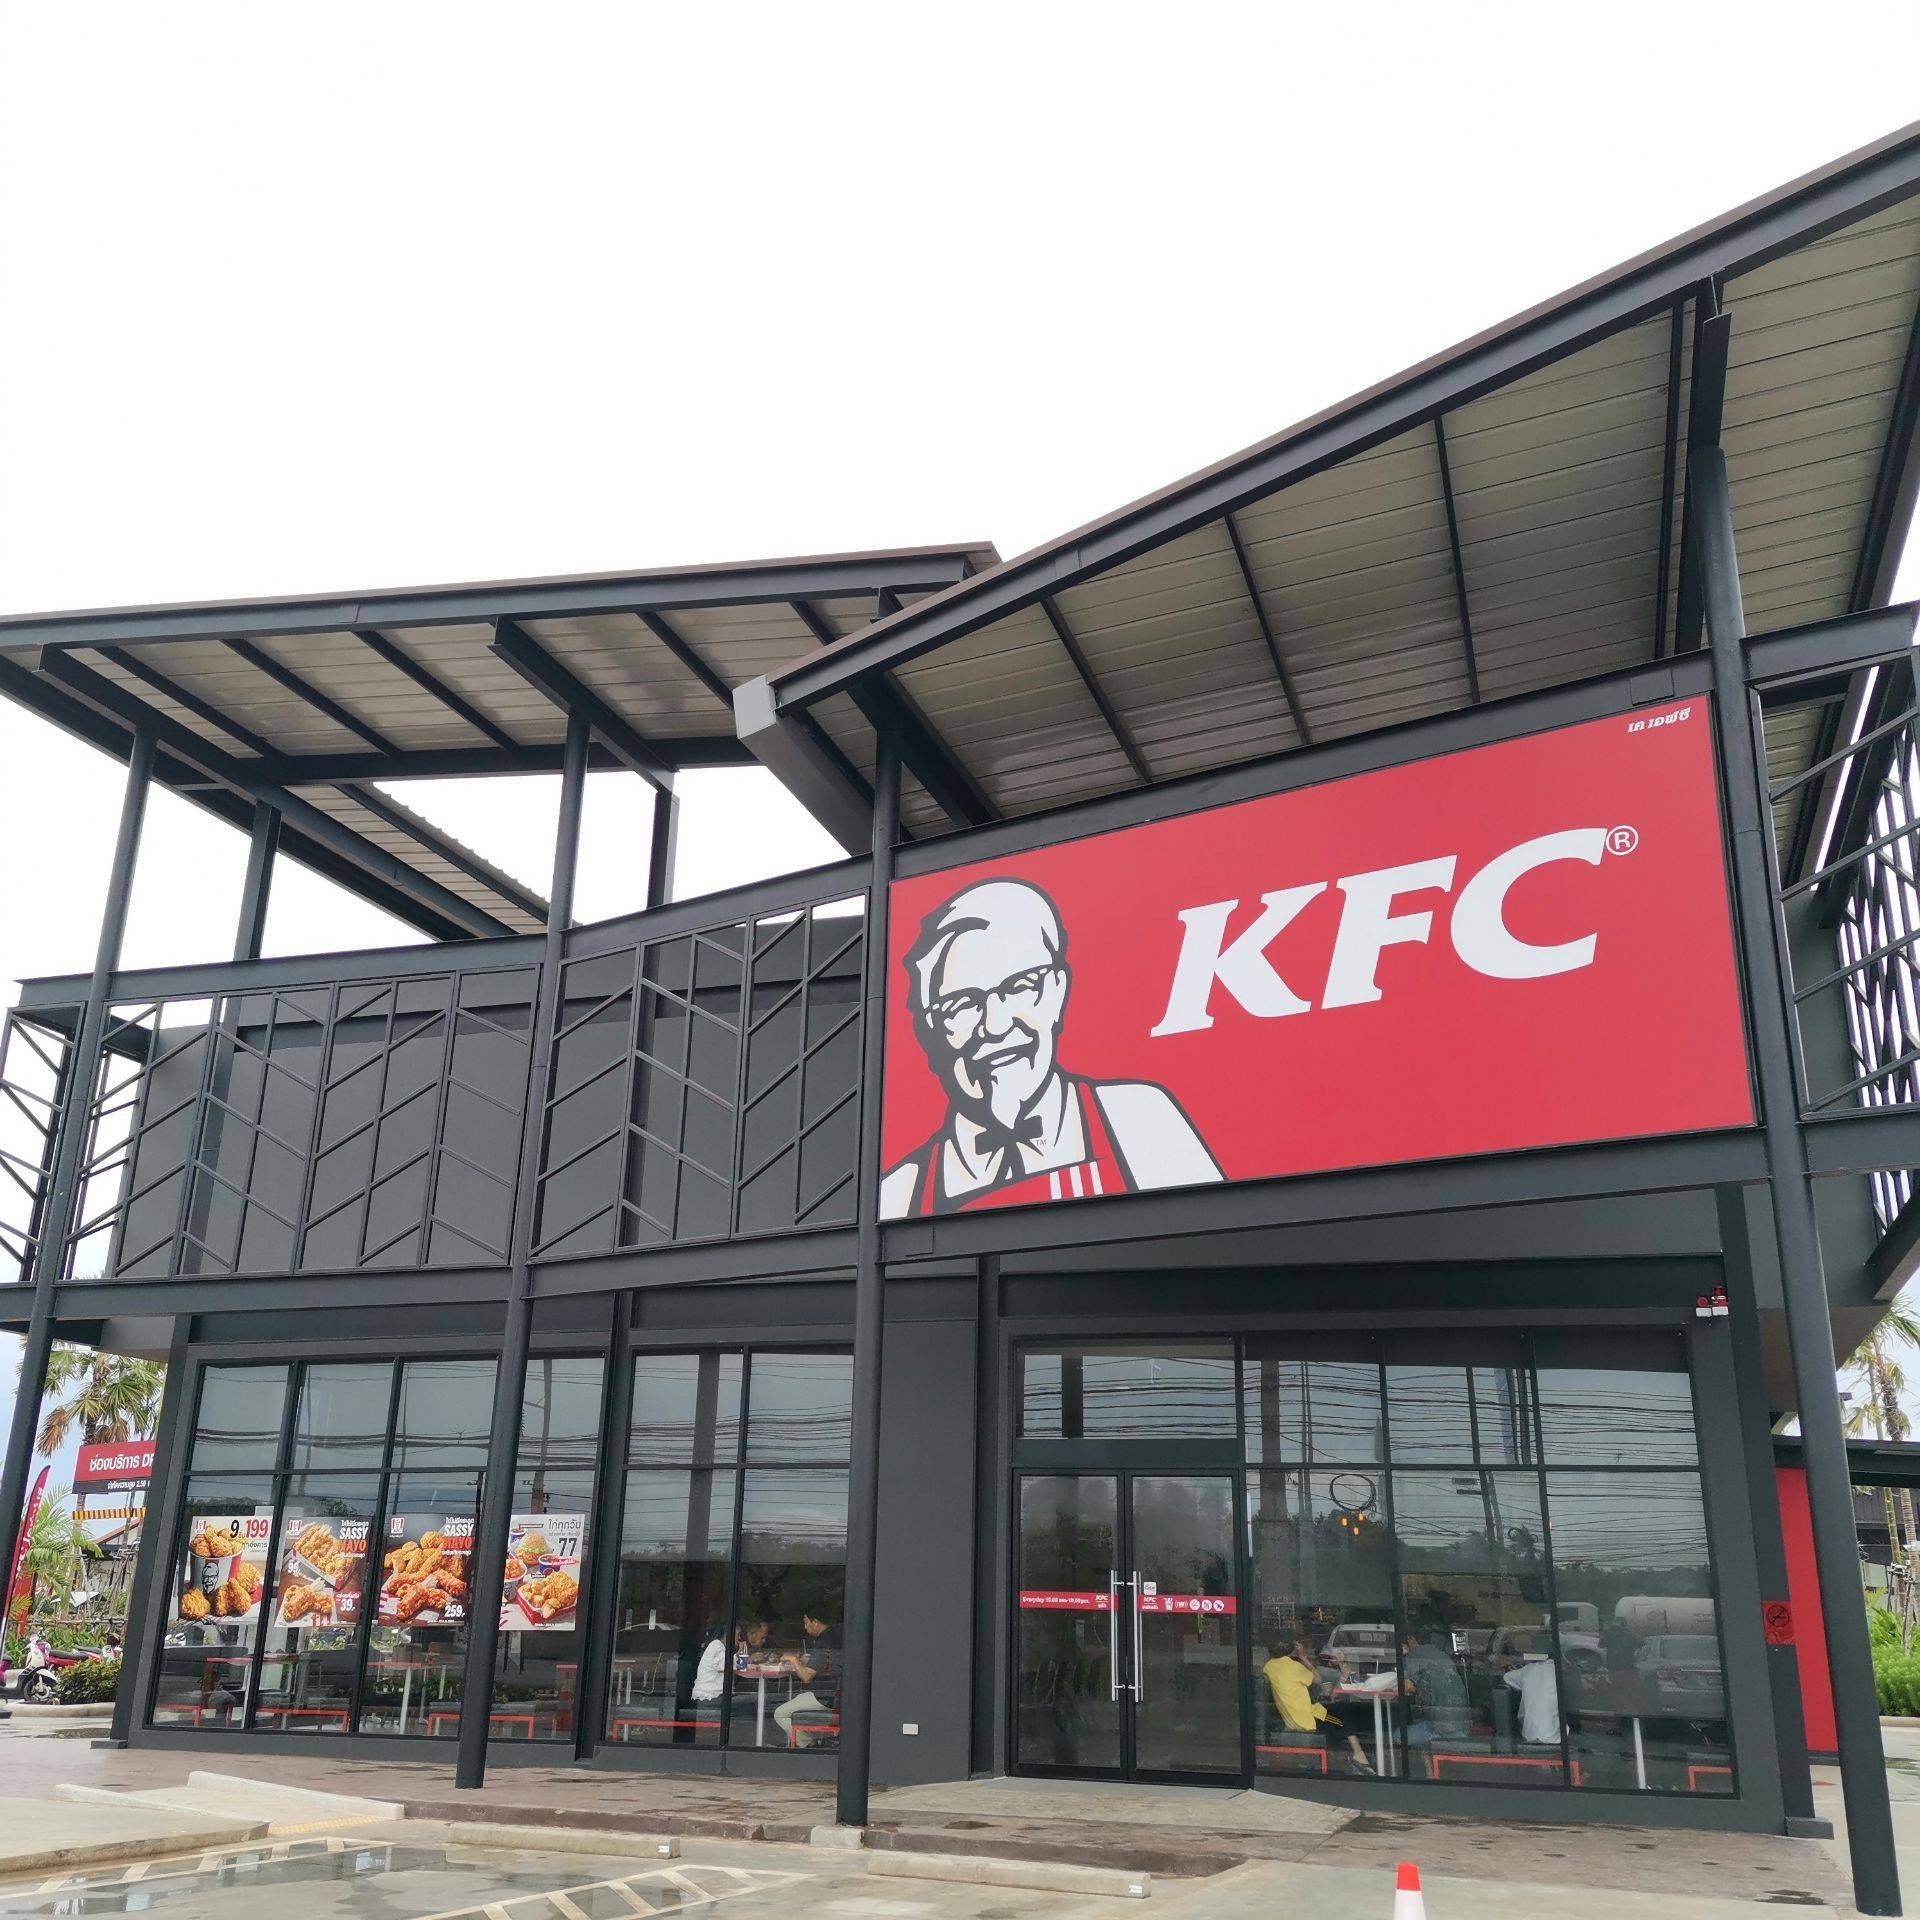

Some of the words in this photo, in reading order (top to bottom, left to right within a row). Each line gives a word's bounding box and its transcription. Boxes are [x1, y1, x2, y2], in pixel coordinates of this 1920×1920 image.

[1628, 721, 1645, 732] เค
[1647, 707, 1691, 728] เอฟซี
[1150, 827, 1608, 1037] KFC
[89, 1454, 140, 1471] ช่องบริการ
[230, 1520, 240, 1538] 9
[340, 1526, 368, 1539] SASSY
[444, 1523, 474, 1537] SASSY
[558, 1537, 578, 1557] 77
[1022, 1596, 1045, 1604] Everyday
